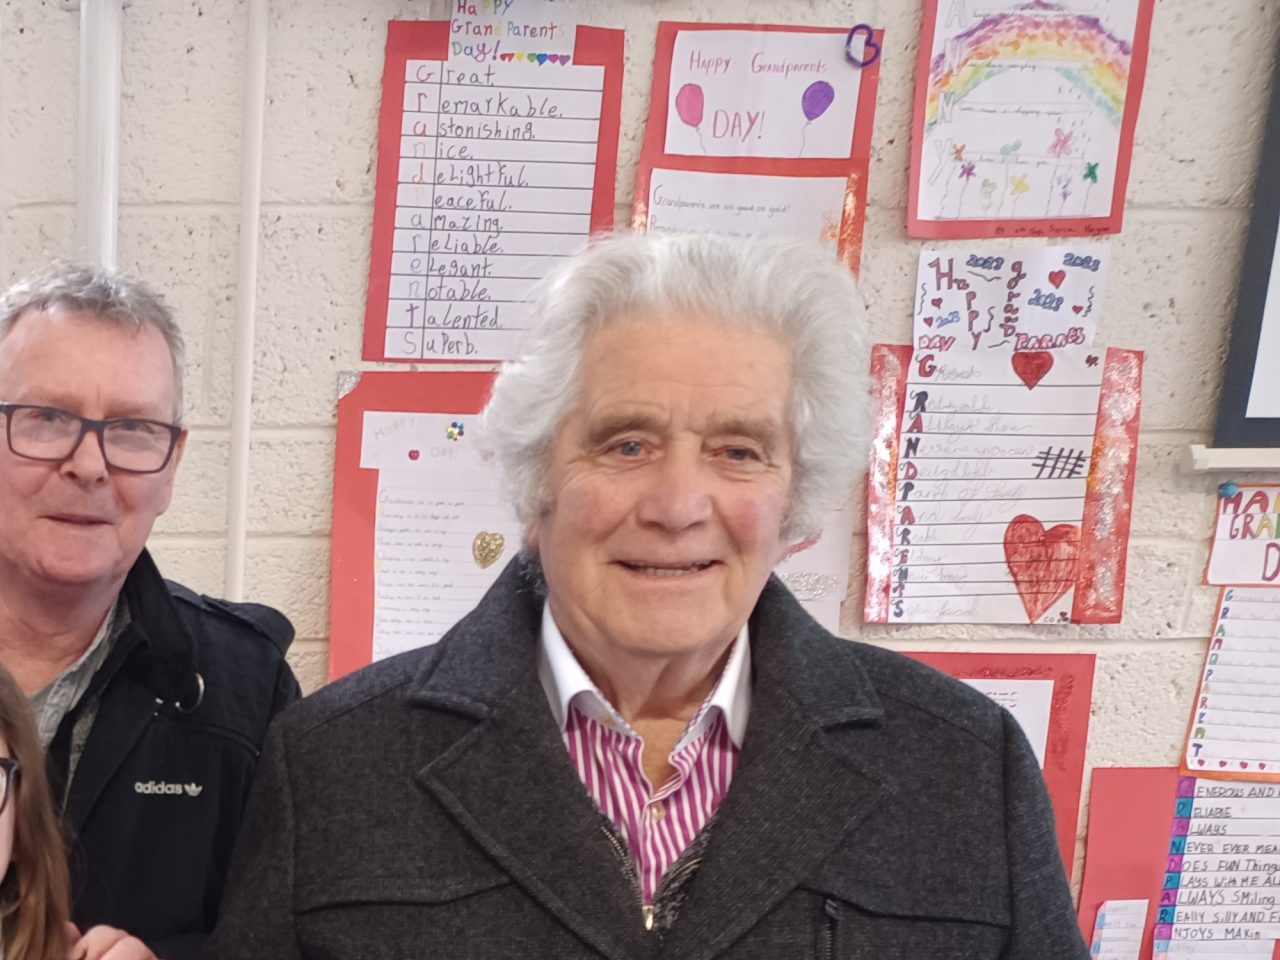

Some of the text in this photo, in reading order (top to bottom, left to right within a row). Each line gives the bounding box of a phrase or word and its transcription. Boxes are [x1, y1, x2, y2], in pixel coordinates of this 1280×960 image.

[452, 40, 501, 63] Day!
[712, 109, 765, 142] DAY!
[134, 781, 183, 795] adidas
